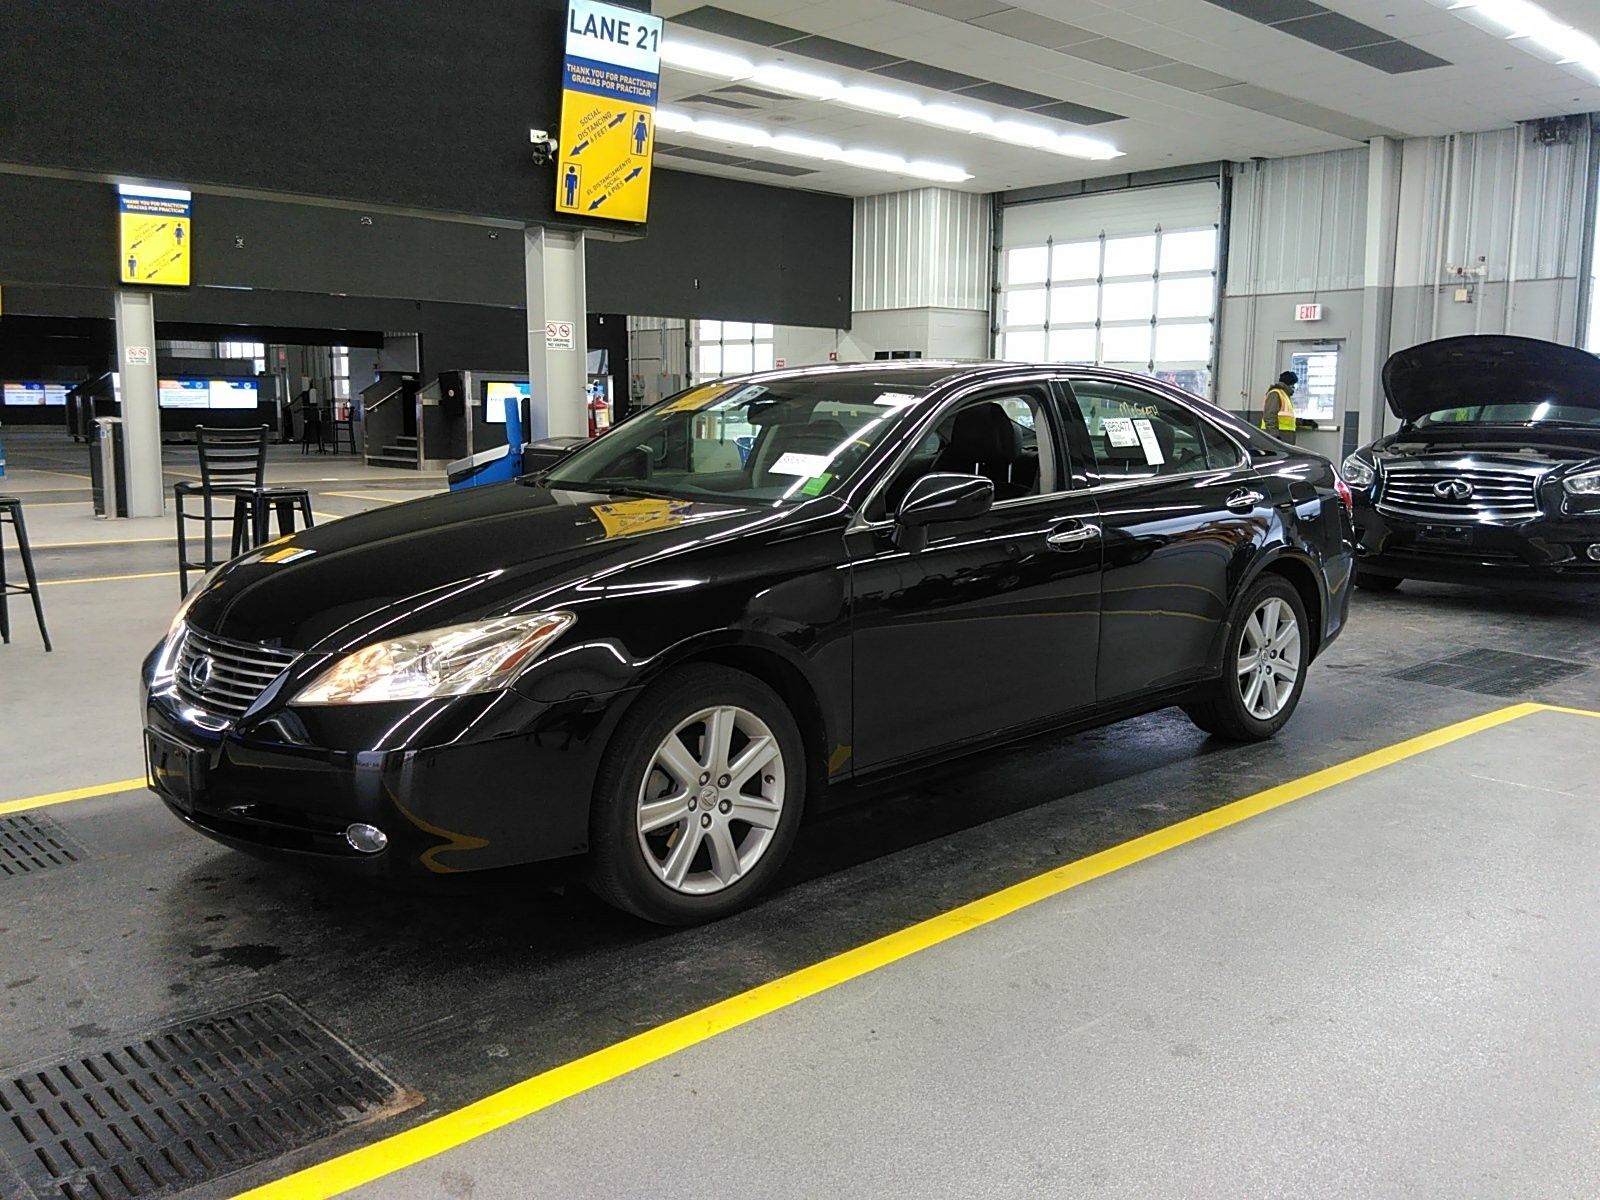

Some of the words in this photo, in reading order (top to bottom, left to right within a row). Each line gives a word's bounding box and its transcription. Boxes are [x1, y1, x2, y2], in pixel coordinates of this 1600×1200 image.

[570, 9, 630, 46] LANE
[636, 26, 658, 52] 21
[566, 63, 590, 76] THANK
[591, 69, 605, 79] YOU
[606, 72, 618, 81] FOR
[619, 75, 657, 90] PRACTICING
[571, 75, 600, 87] GRACIAS
[601, 80, 615, 90] POR
[616, 83, 651, 97] PRACTICAR
[577, 111, 612, 141] DISTANCING
[579, 107, 601, 127] SOCIAL
[593, 125, 608, 140] FEET
[1300, 305, 1317, 319] EXIT
